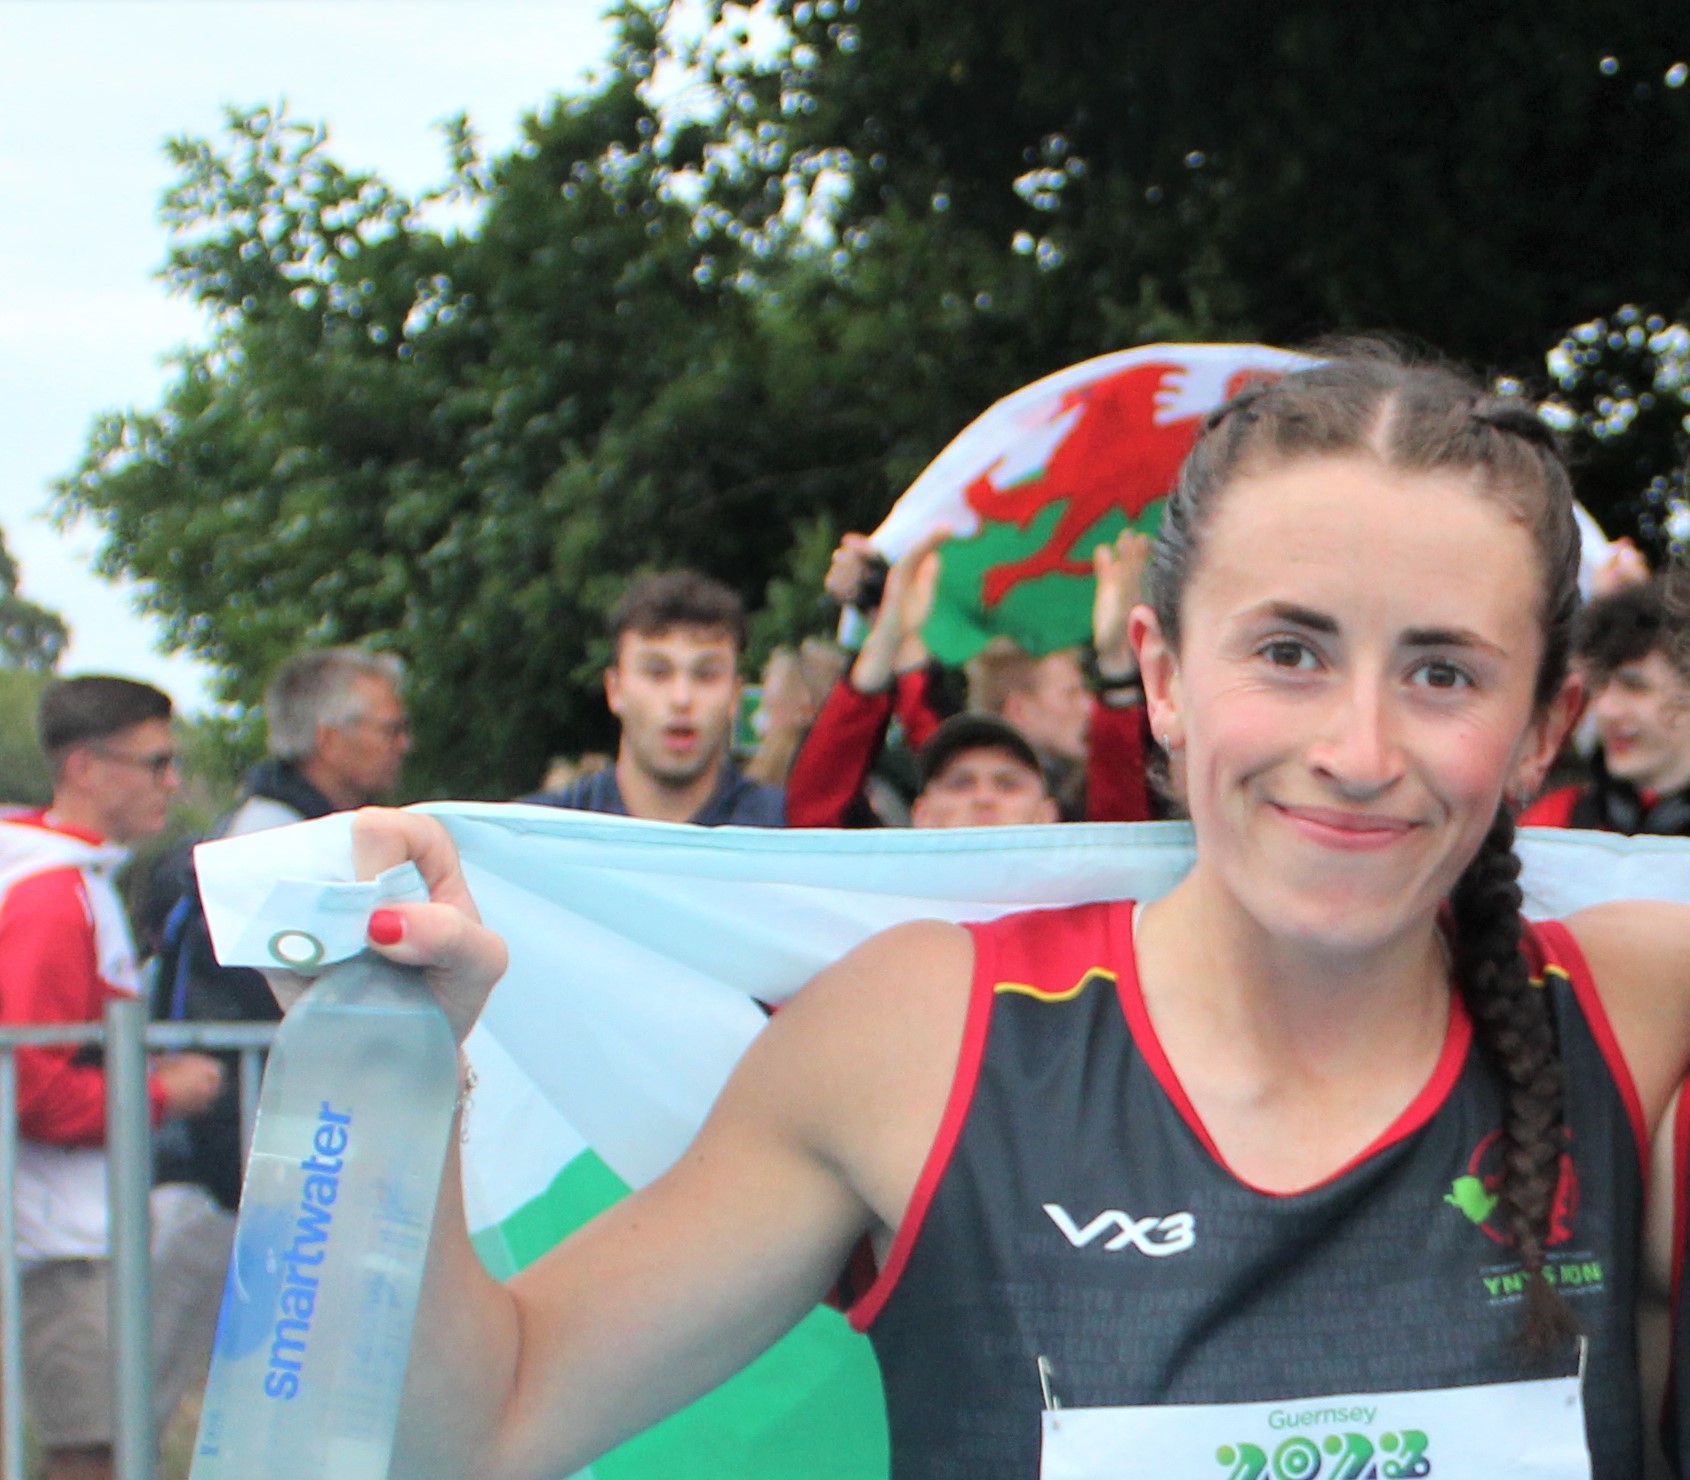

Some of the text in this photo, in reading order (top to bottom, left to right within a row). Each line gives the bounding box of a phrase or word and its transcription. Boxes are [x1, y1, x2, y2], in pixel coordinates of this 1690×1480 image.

[264, 1101, 352, 1401] smartwater
[1042, 1203, 1196, 1257] VX3
[1268, 1405, 1378, 1430] Guernsey
